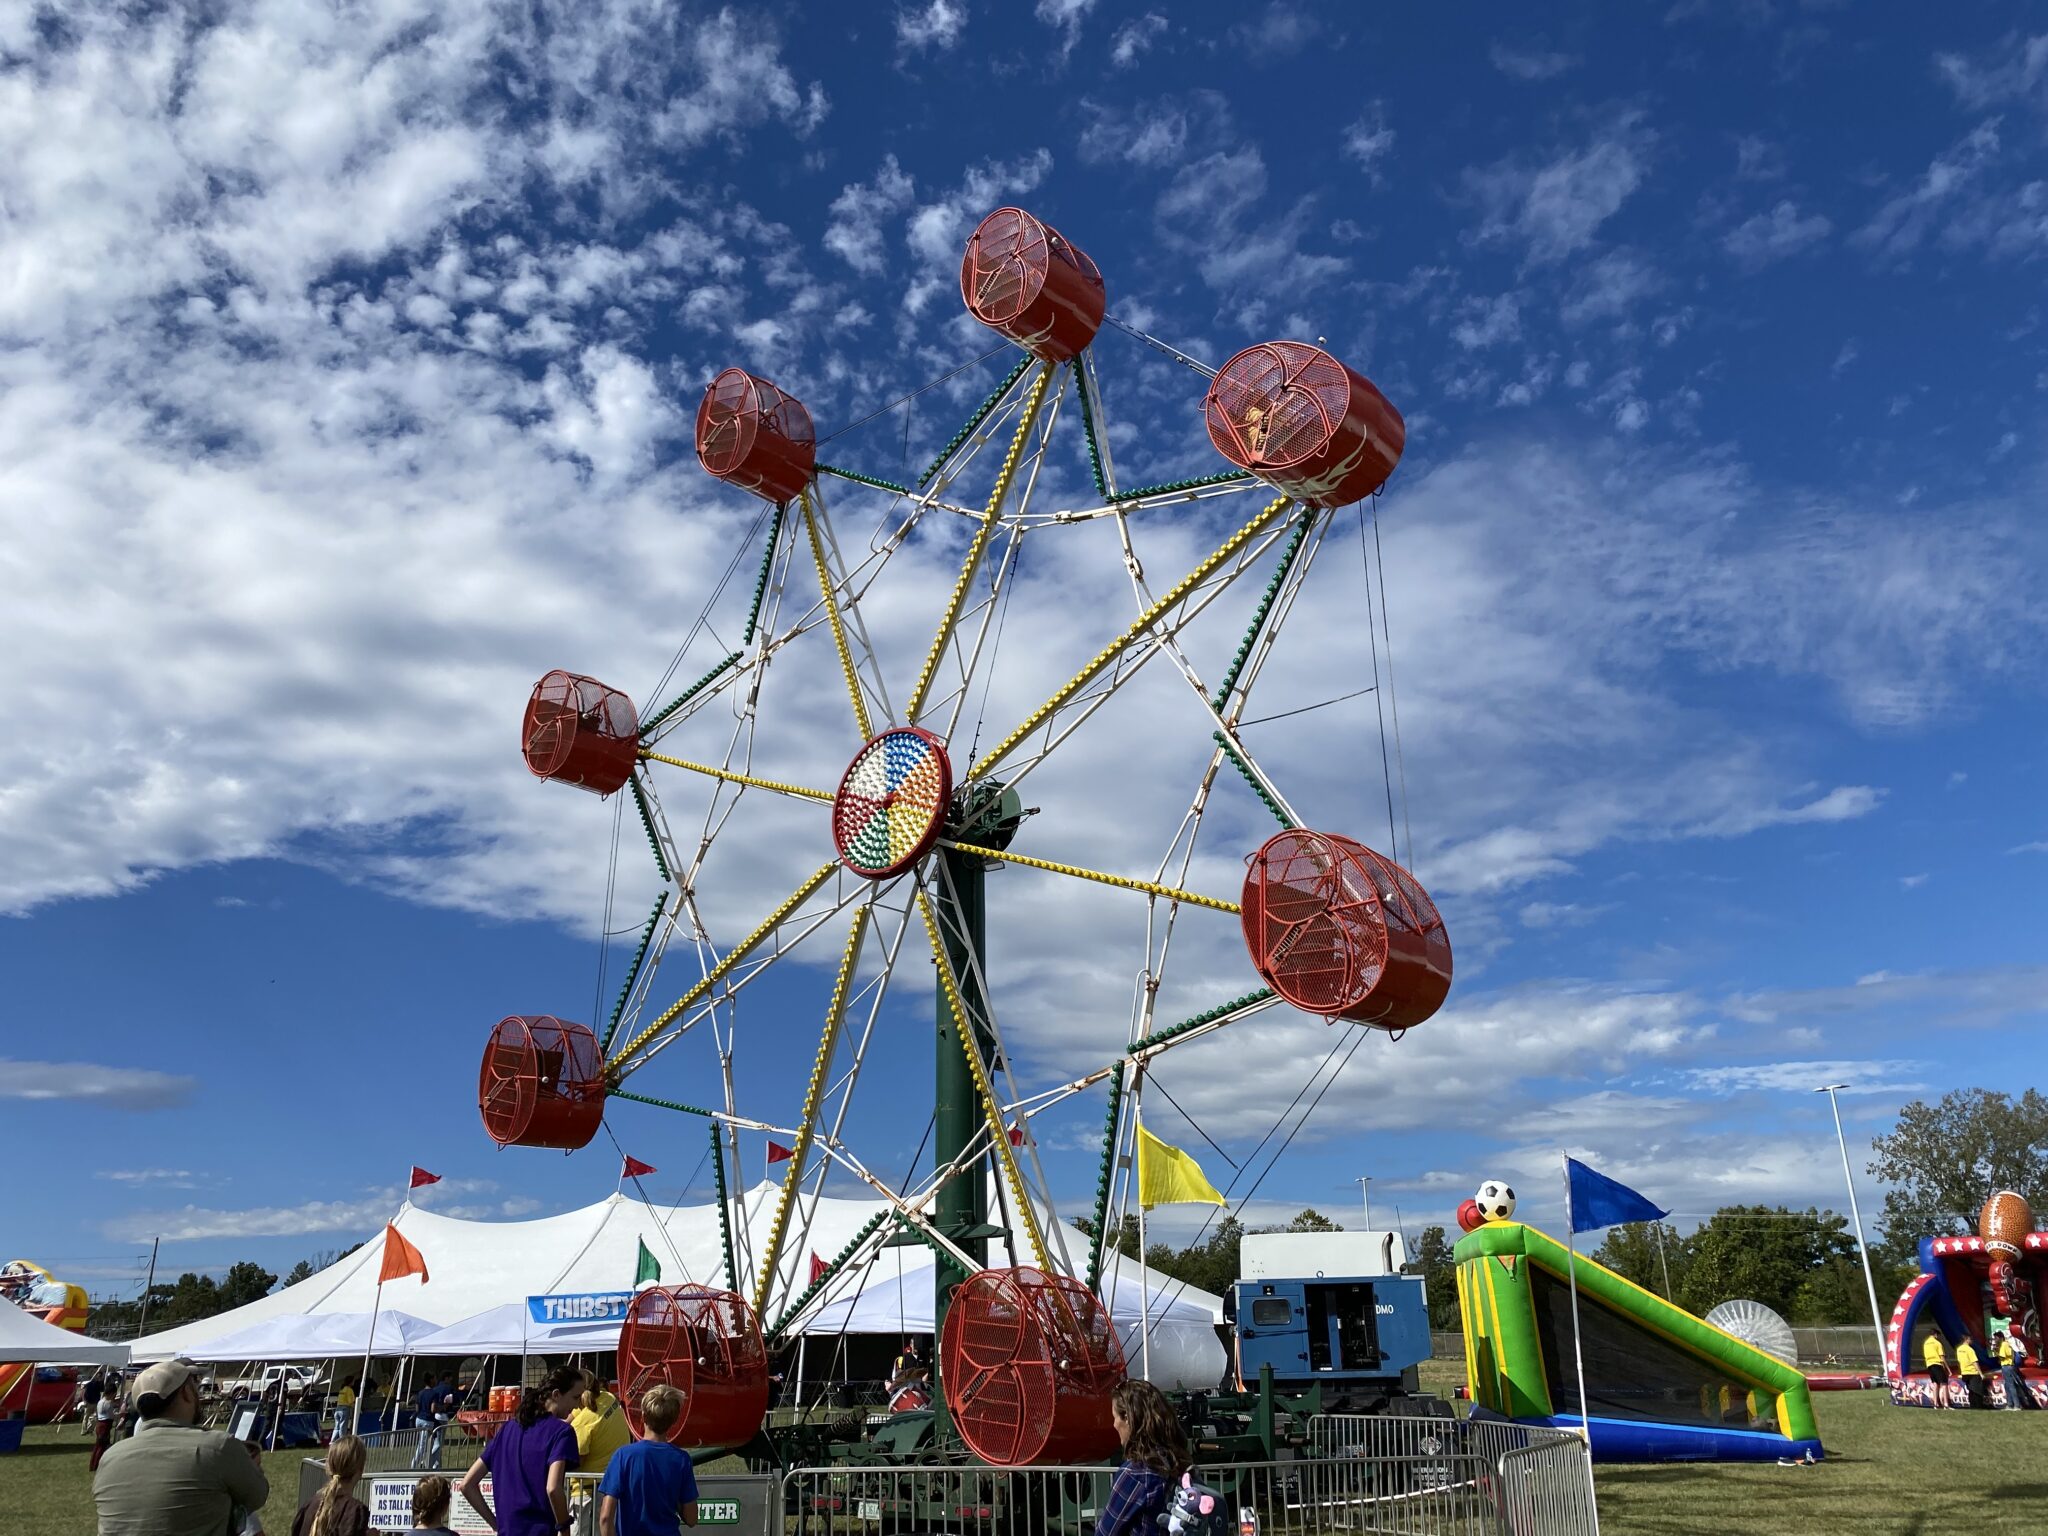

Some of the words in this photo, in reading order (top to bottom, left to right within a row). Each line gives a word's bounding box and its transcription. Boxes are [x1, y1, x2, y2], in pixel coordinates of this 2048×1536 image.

[1997, 1242, 2017, 1252] DOWN
[374, 1484, 388, 1496] YOU
[389, 1484, 409, 1496] MUST
[378, 1499, 388, 1511] AS
[389, 1499, 403, 1511] TALL
[371, 1514, 392, 1526] FENCE
[393, 1514, 402, 1526] TO
